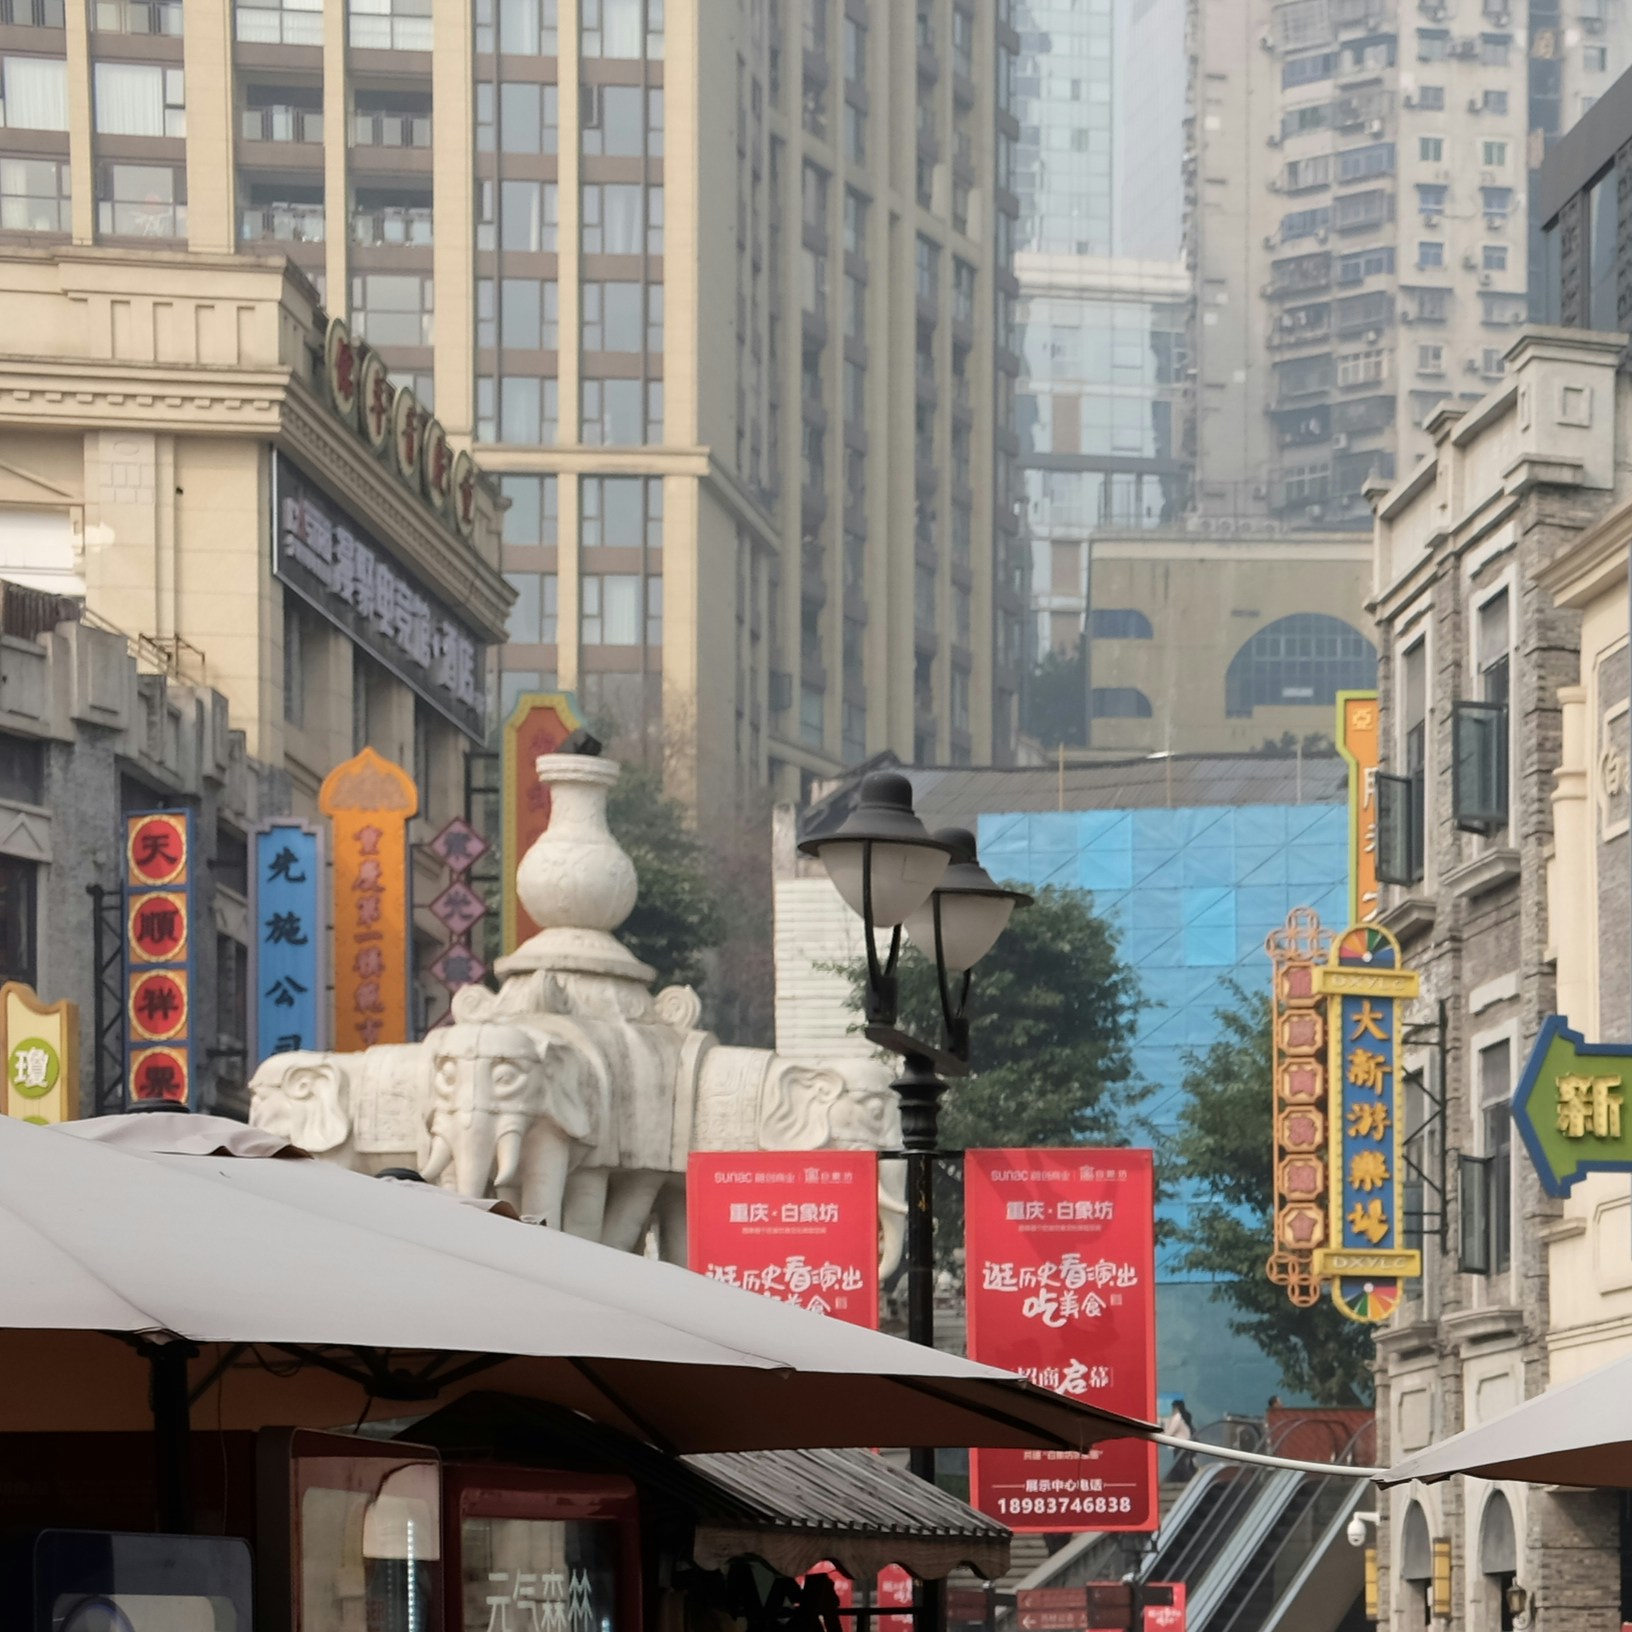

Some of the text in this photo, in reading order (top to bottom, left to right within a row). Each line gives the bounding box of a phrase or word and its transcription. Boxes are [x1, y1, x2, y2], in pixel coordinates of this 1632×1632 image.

[982, 1252, 1139, 1292] 逛历史看演出
[1022, 1286, 1107, 1328] 吃美食
[1025, 1478, 1104, 1493] 展示中心电话
[997, 1496, 1132, 1515] 18983746838
